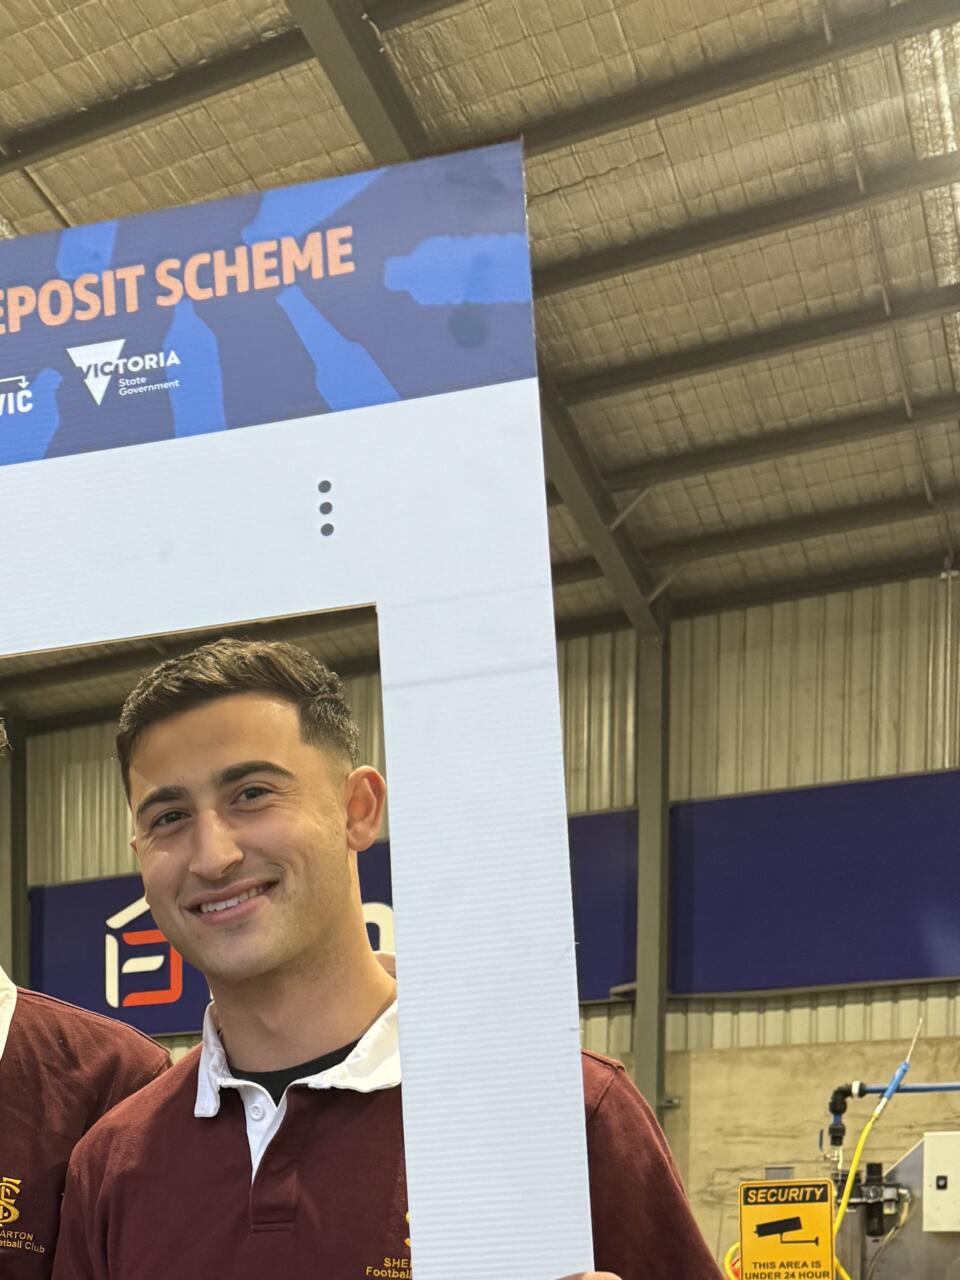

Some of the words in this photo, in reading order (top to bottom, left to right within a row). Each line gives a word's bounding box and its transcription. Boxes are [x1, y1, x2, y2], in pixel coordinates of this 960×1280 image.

[155, 226, 355, 306] SCHEME
[76, 350, 181, 380] VICTORIA
[119, 377, 147, 387] State
[119, 379, 180, 396] Government
[747, 1187, 824, 1203] SECURITY
[25, 1242, 45, 1253] Club
[383, 1257, 412, 1268] SHE
[752, 1261, 776, 1270] THIS
[779, 1261, 809, 1270] AREA
[811, 1260, 821, 1269] IS
[745, 1271, 782, 1280] UNDER
[783, 1271, 796, 1280] 24
[799, 1270, 830, 1279] HOUR
